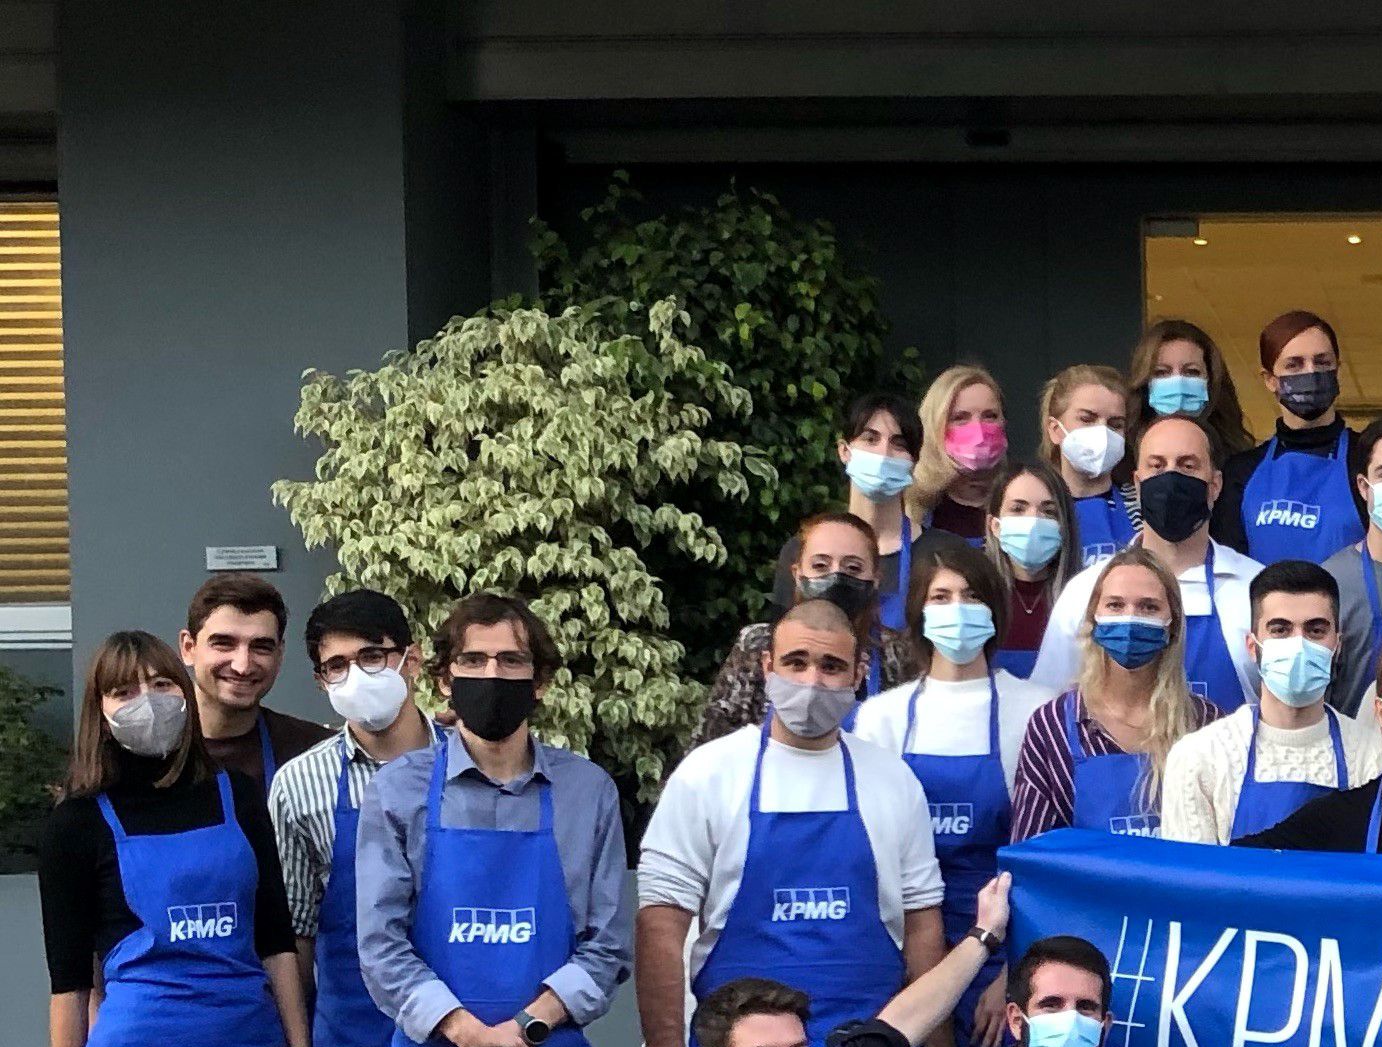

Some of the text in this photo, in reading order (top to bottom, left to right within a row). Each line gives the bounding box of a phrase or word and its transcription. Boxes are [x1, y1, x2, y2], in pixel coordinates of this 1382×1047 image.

[1256, 509, 1317, 529] KPMG
[931, 815, 970, 834] MG
[771, 900, 847, 921] KPMG
[170, 916, 234, 943] KPMG
[447, 922, 532, 943] KPMG
